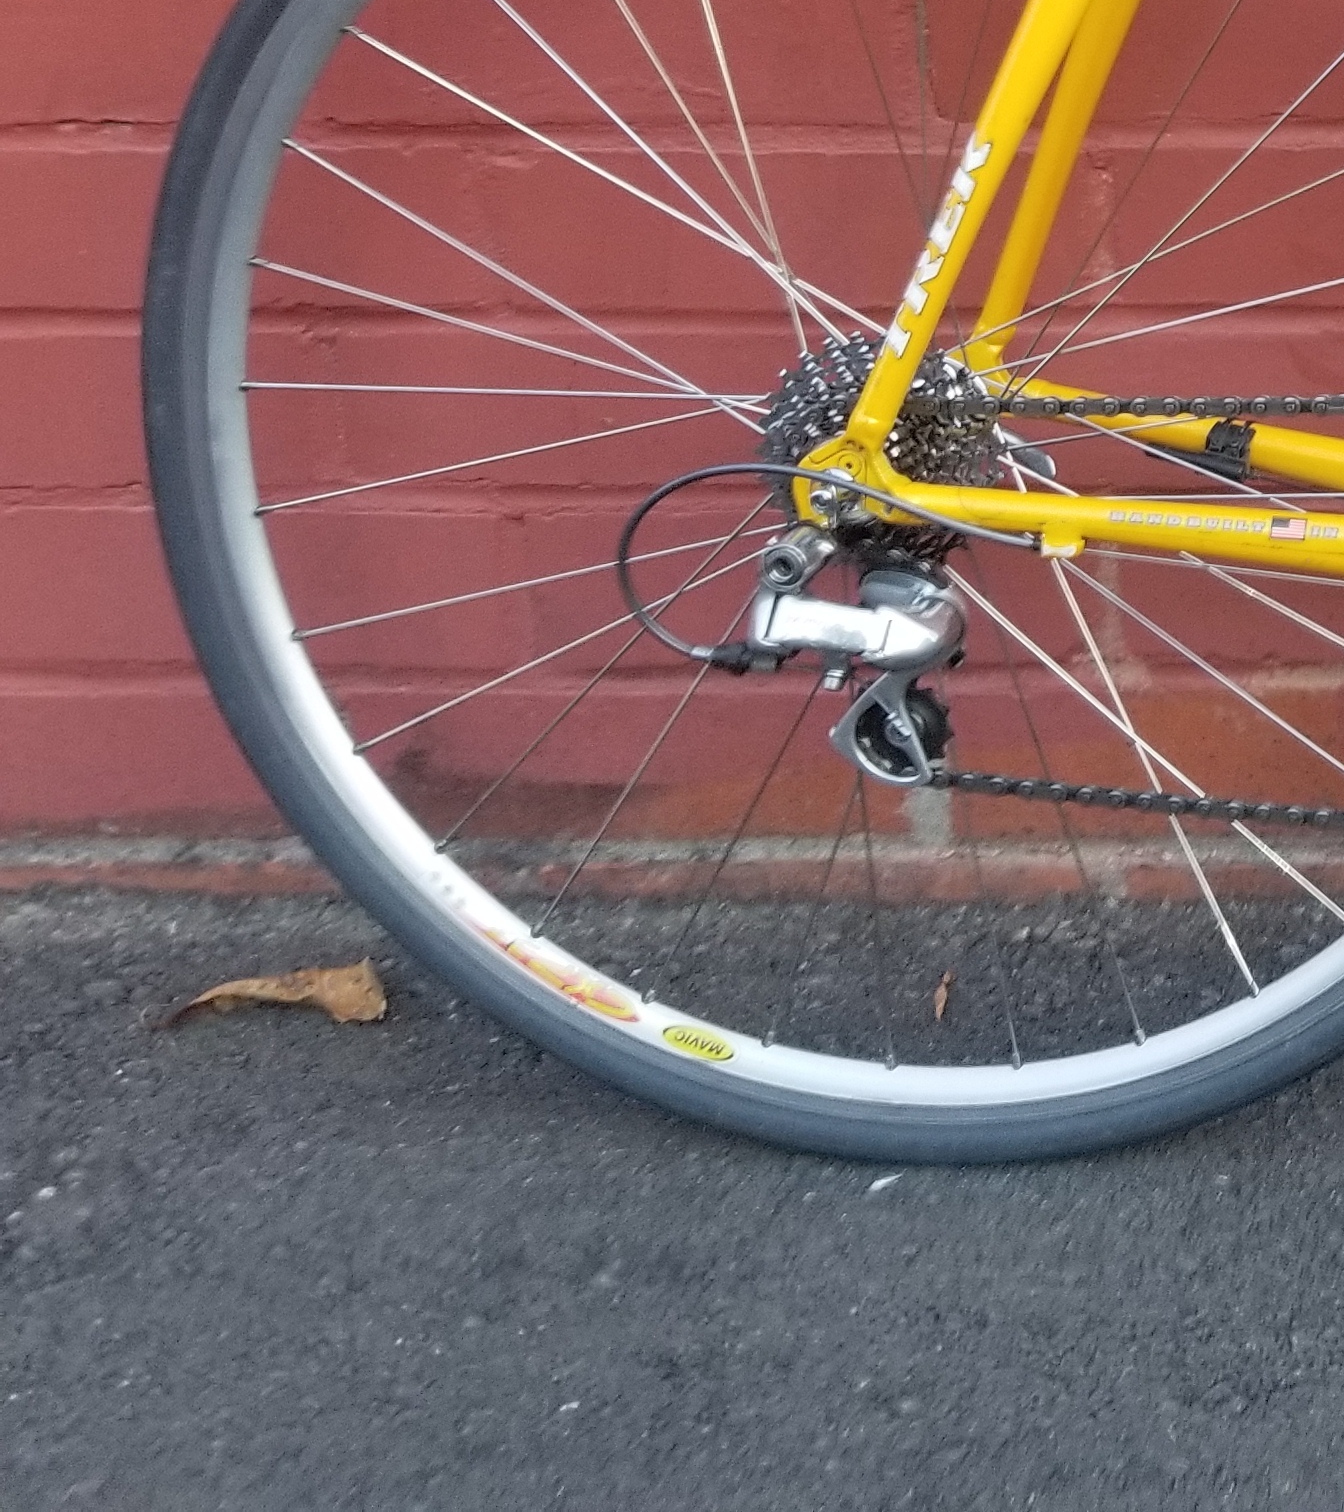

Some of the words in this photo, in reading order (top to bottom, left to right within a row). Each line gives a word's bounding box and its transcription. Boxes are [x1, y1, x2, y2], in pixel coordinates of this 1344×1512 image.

[1110, 511, 1266, 533] HANDBUILT
[1311, 525, 1339, 539] IN
[673, 1028, 726, 1056] MAVIC
